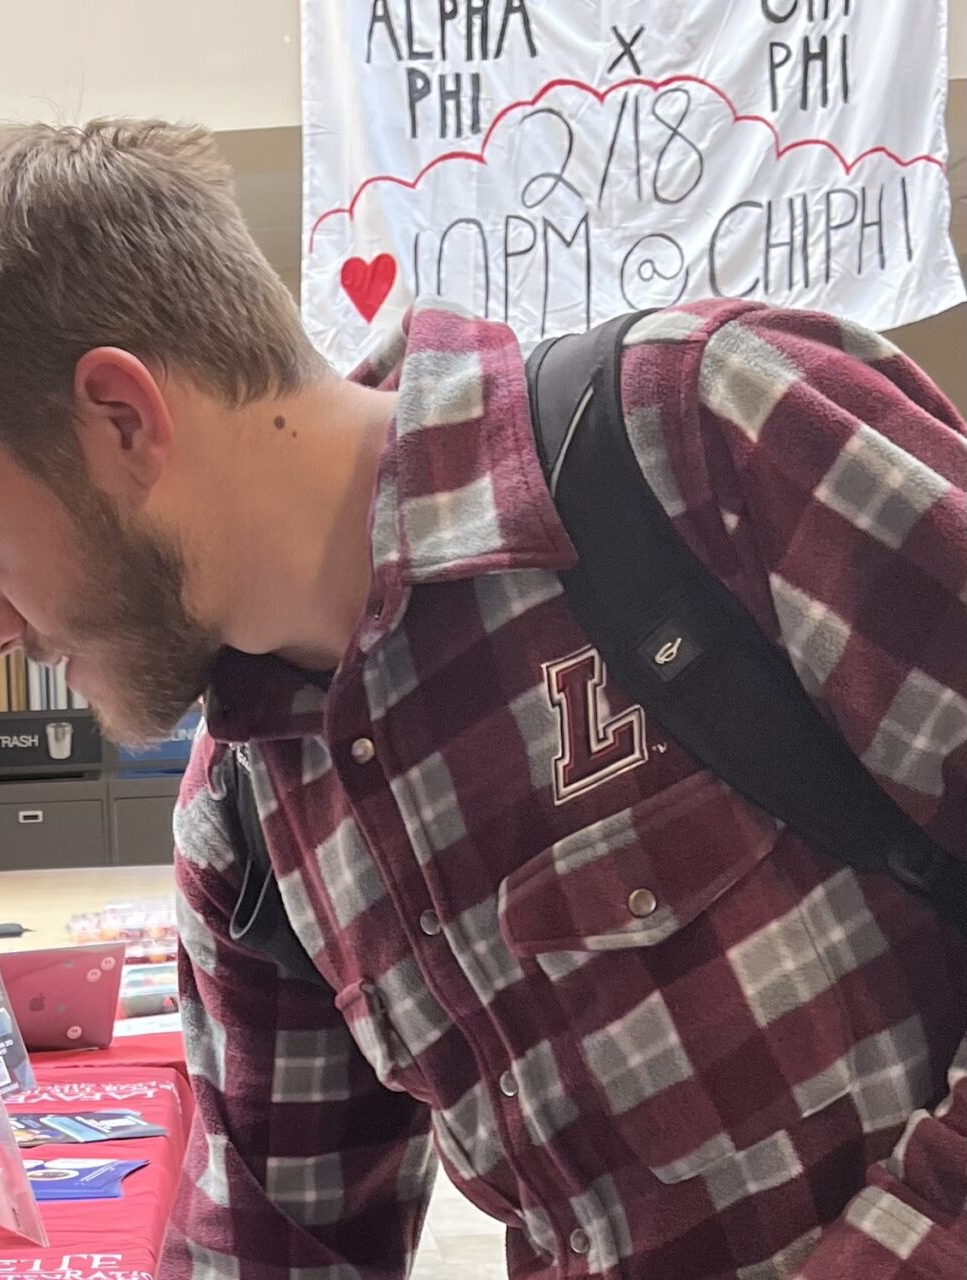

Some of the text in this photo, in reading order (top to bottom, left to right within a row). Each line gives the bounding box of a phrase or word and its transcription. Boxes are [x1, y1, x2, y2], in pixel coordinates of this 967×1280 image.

[365, 0, 538, 64] ALPHA
[406, 66, 481, 139] PHI
[769, 33, 849, 112] PHI
[521, 87, 705, 210] 2/18
